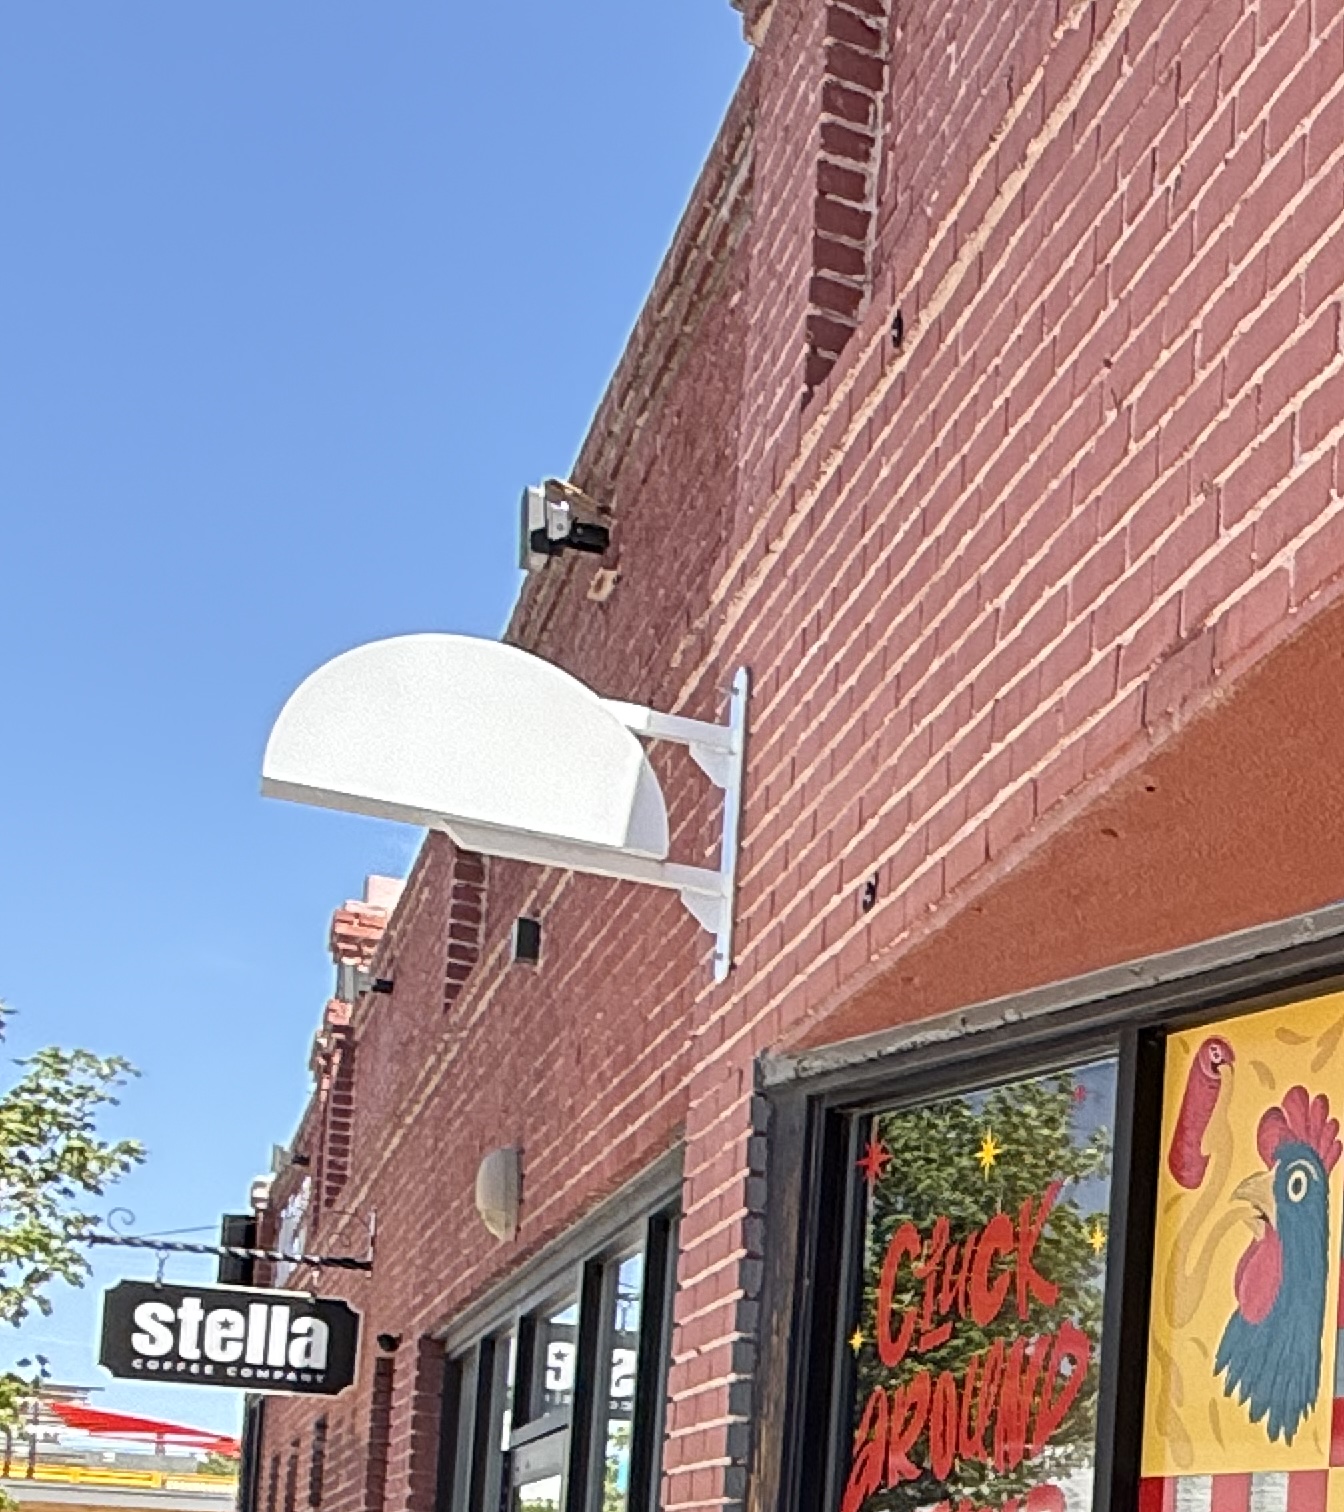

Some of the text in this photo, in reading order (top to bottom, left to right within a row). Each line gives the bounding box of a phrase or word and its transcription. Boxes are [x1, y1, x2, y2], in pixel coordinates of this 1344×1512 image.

[130, 1296, 330, 1370] stella
[131, 1357, 327, 1384] COFFEE COMPANY
